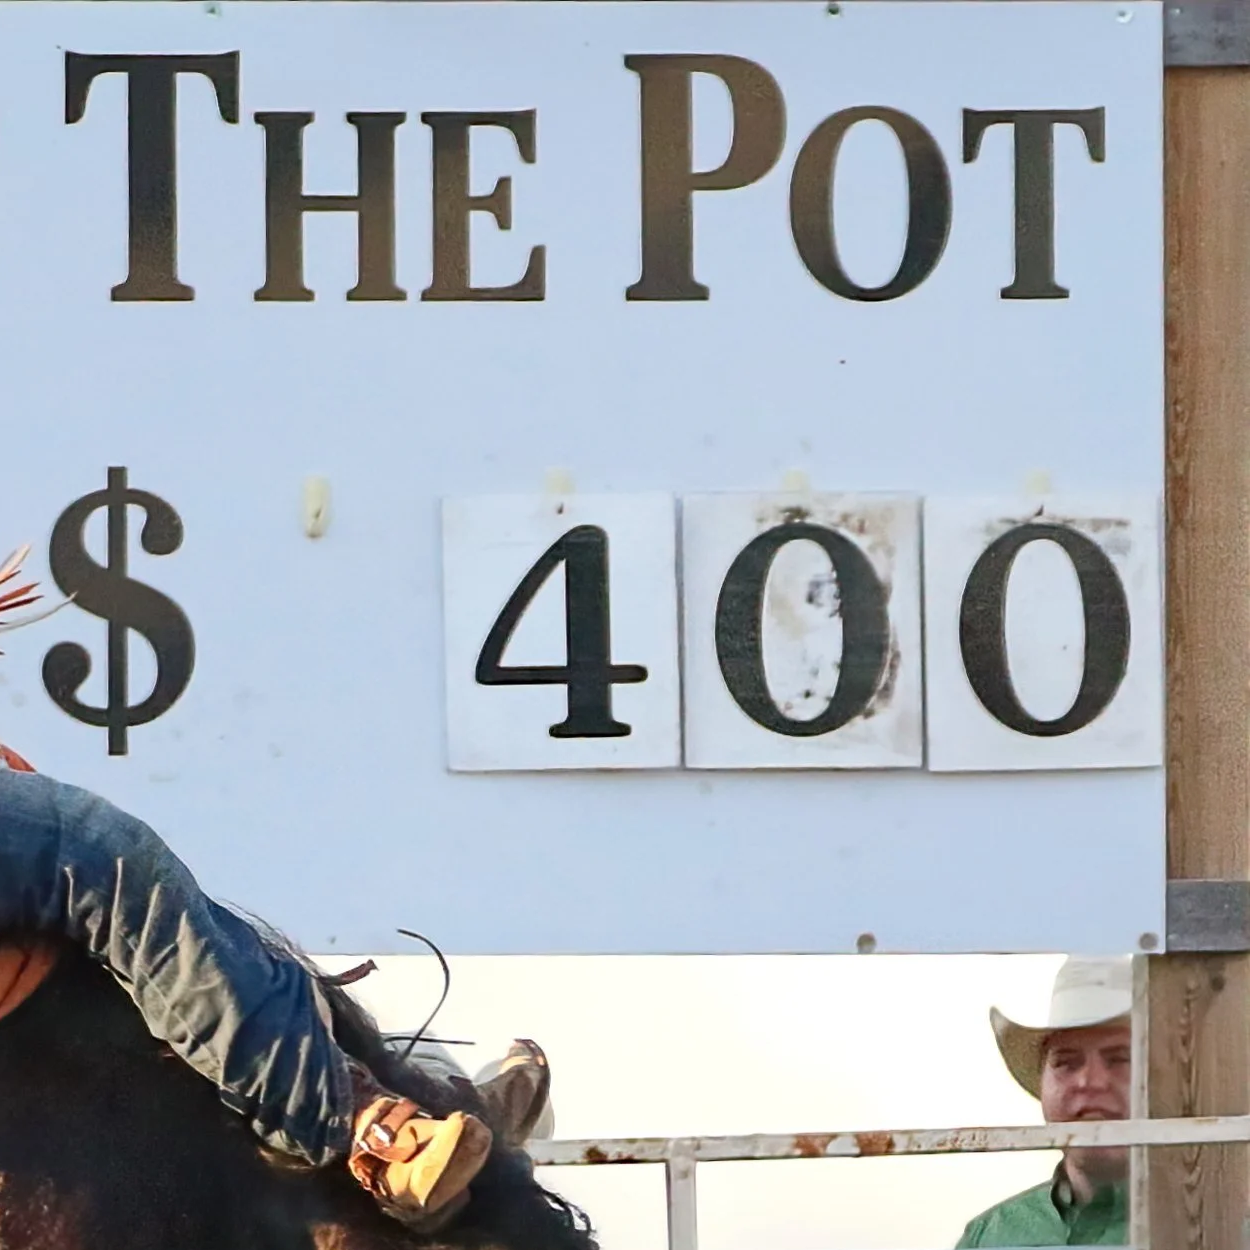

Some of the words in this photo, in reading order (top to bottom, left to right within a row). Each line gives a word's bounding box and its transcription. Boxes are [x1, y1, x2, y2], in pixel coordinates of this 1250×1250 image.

[64, 50, 546, 302] THE
[623, 53, 1107, 302] POT
[41, 466, 196, 756] $
[474, 524, 1132, 738] 400
